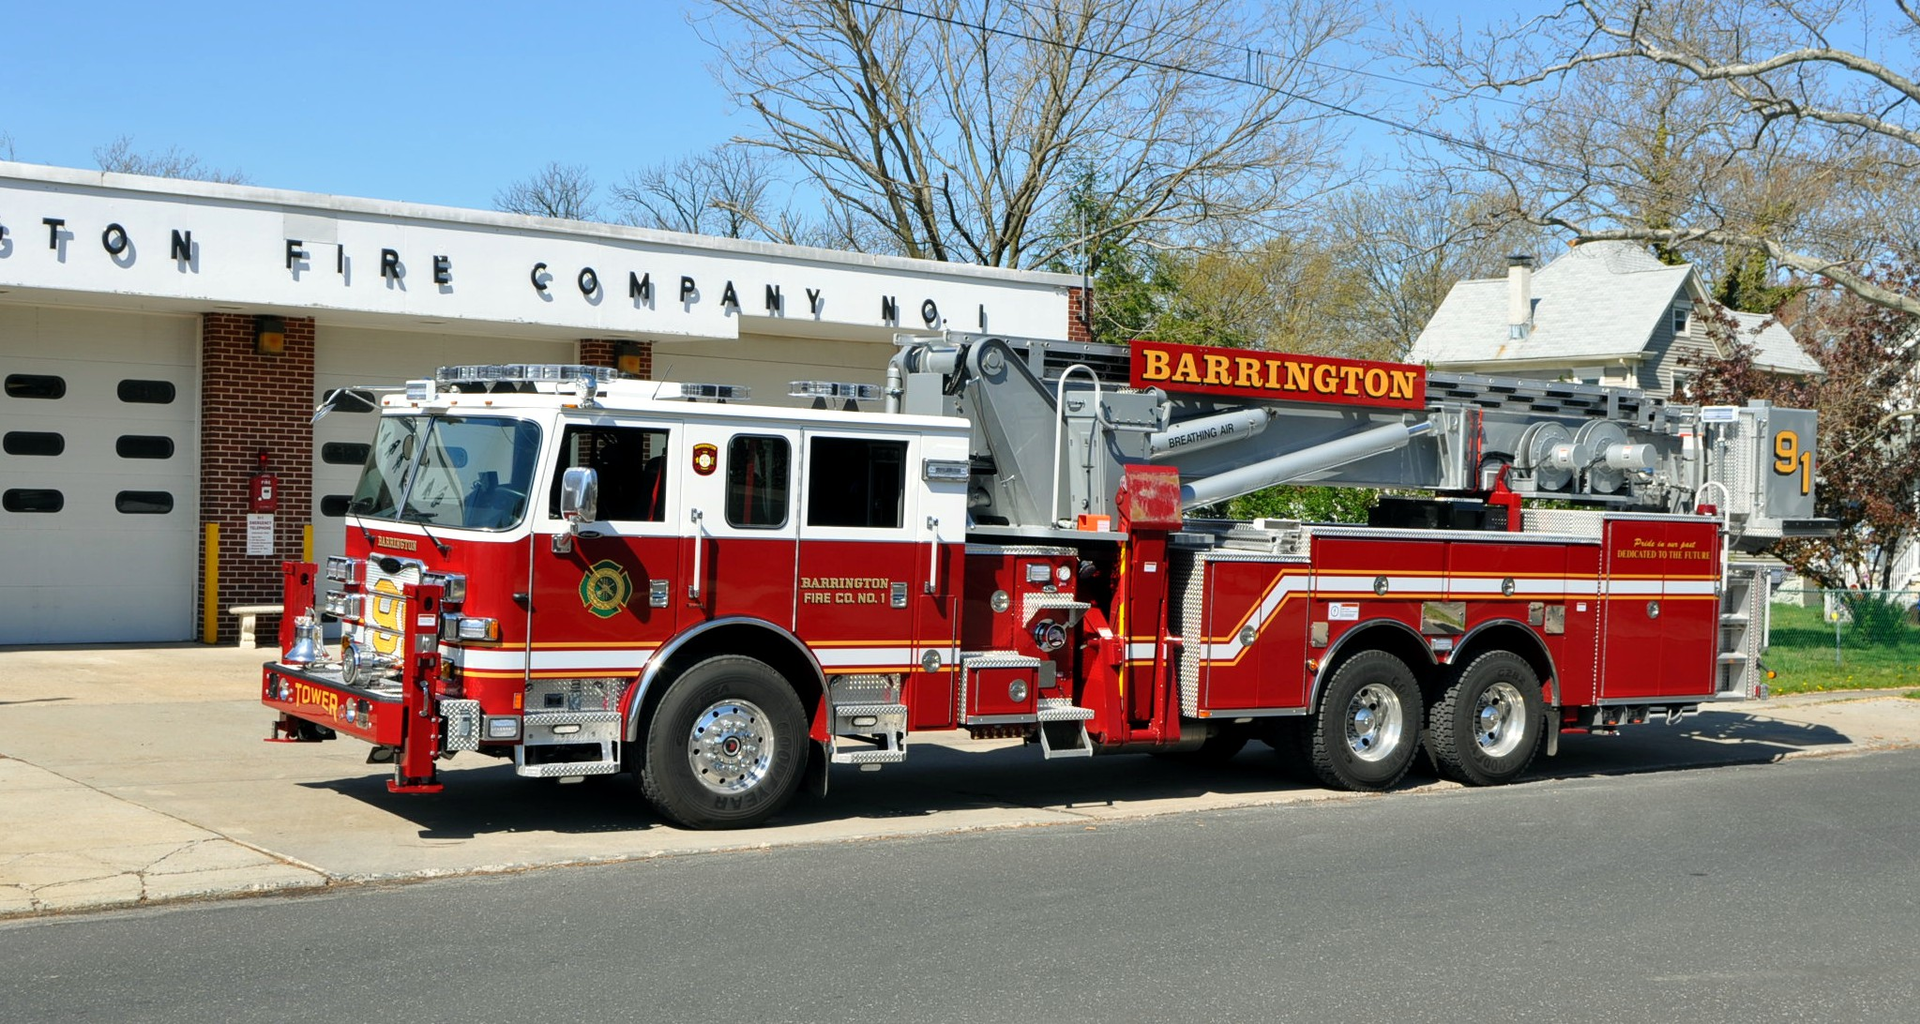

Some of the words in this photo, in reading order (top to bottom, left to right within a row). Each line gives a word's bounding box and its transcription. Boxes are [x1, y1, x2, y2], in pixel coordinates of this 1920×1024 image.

[0, 217, 191, 260] TON
[286, 239, 448, 284] FIRE
[531, 262, 820, 313] COMPANY
[882, 295, 947, 323] NO.
[1142, 349, 1417, 400] BARRINGTON
[1168, 427, 1217, 448] BREATHING
[1220, 423, 1234, 436] AIR
[1773, 430, 1811, 497] 91
[377, 535, 417, 552] BARRINGTON
[1634, 538, 1655, 548] Pride
[1679, 541, 1697, 550] past
[1617, 549, 1657, 559] DEDICATED
[1659, 550, 1667, 559] TO
[1669, 550, 1683, 559] THE
[1684, 551, 1711, 560] FUTURE
[801, 577, 889, 589] BARRINGTON
[804, 592, 831, 604] FIRE
[835, 592, 855, 604] CO.
[858, 592, 878, 604] NO.
[880, 593, 886, 604] 1
[295, 682, 338, 722] TOWER
